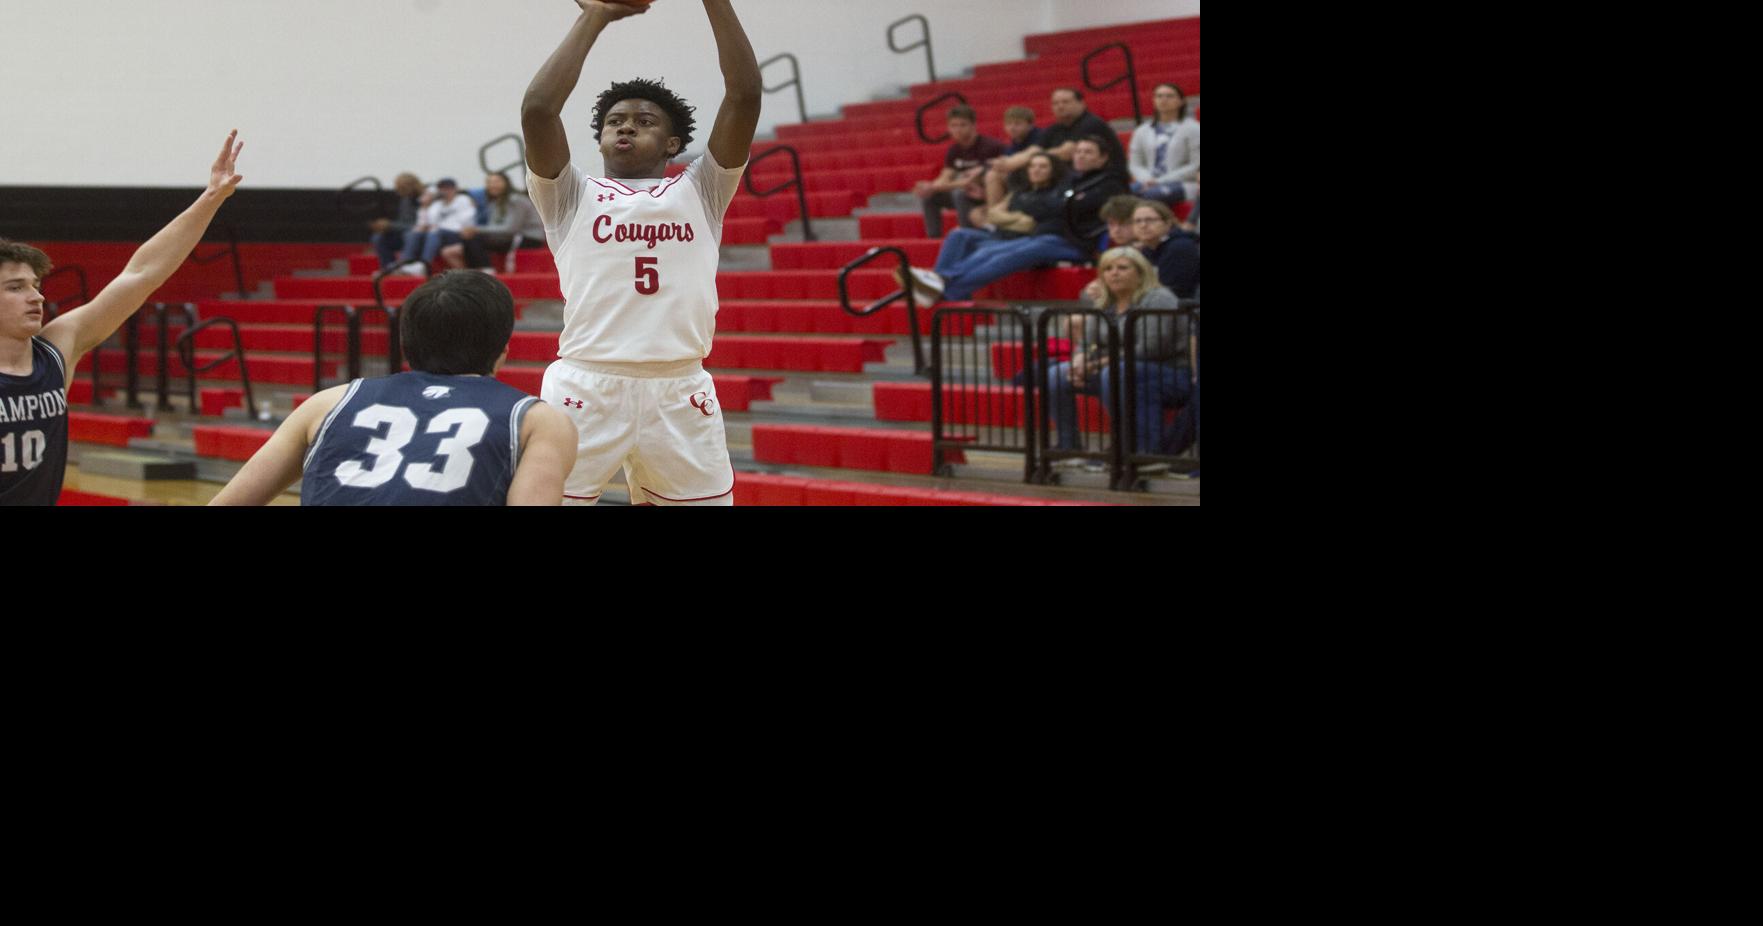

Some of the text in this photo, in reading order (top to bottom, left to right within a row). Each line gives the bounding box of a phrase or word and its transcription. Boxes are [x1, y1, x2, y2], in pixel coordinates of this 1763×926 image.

[592, 214, 694, 249] Cougars
[634, 256, 659, 295] 5
[1, 429, 46, 472] 10
[334, 403, 490, 493] 33
